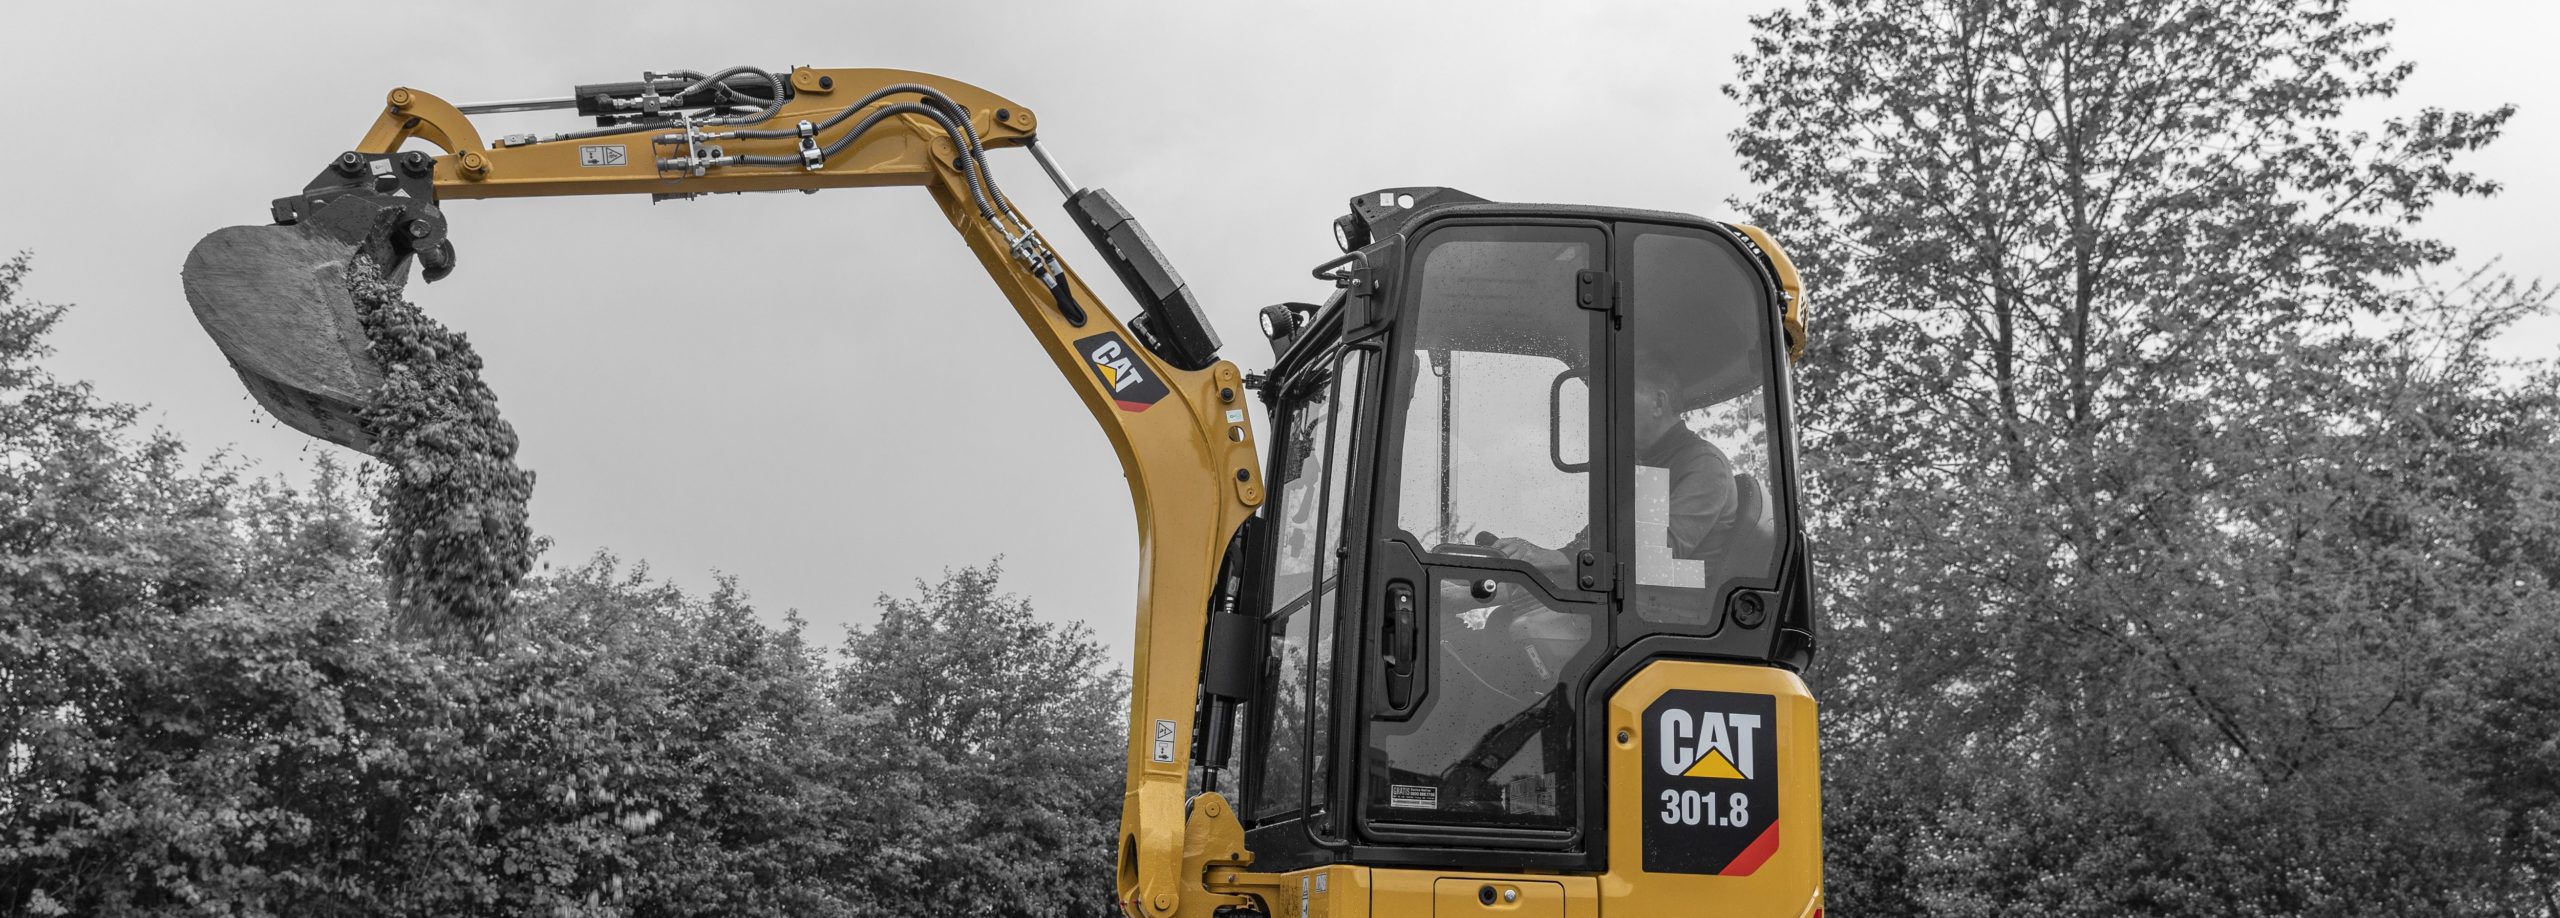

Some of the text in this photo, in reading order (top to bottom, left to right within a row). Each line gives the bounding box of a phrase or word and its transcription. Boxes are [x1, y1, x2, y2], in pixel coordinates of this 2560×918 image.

[1091, 340, 1143, 393] CAT
[1660, 708, 1761, 779] CAT
[1661, 789, 1749, 827] 301.8
